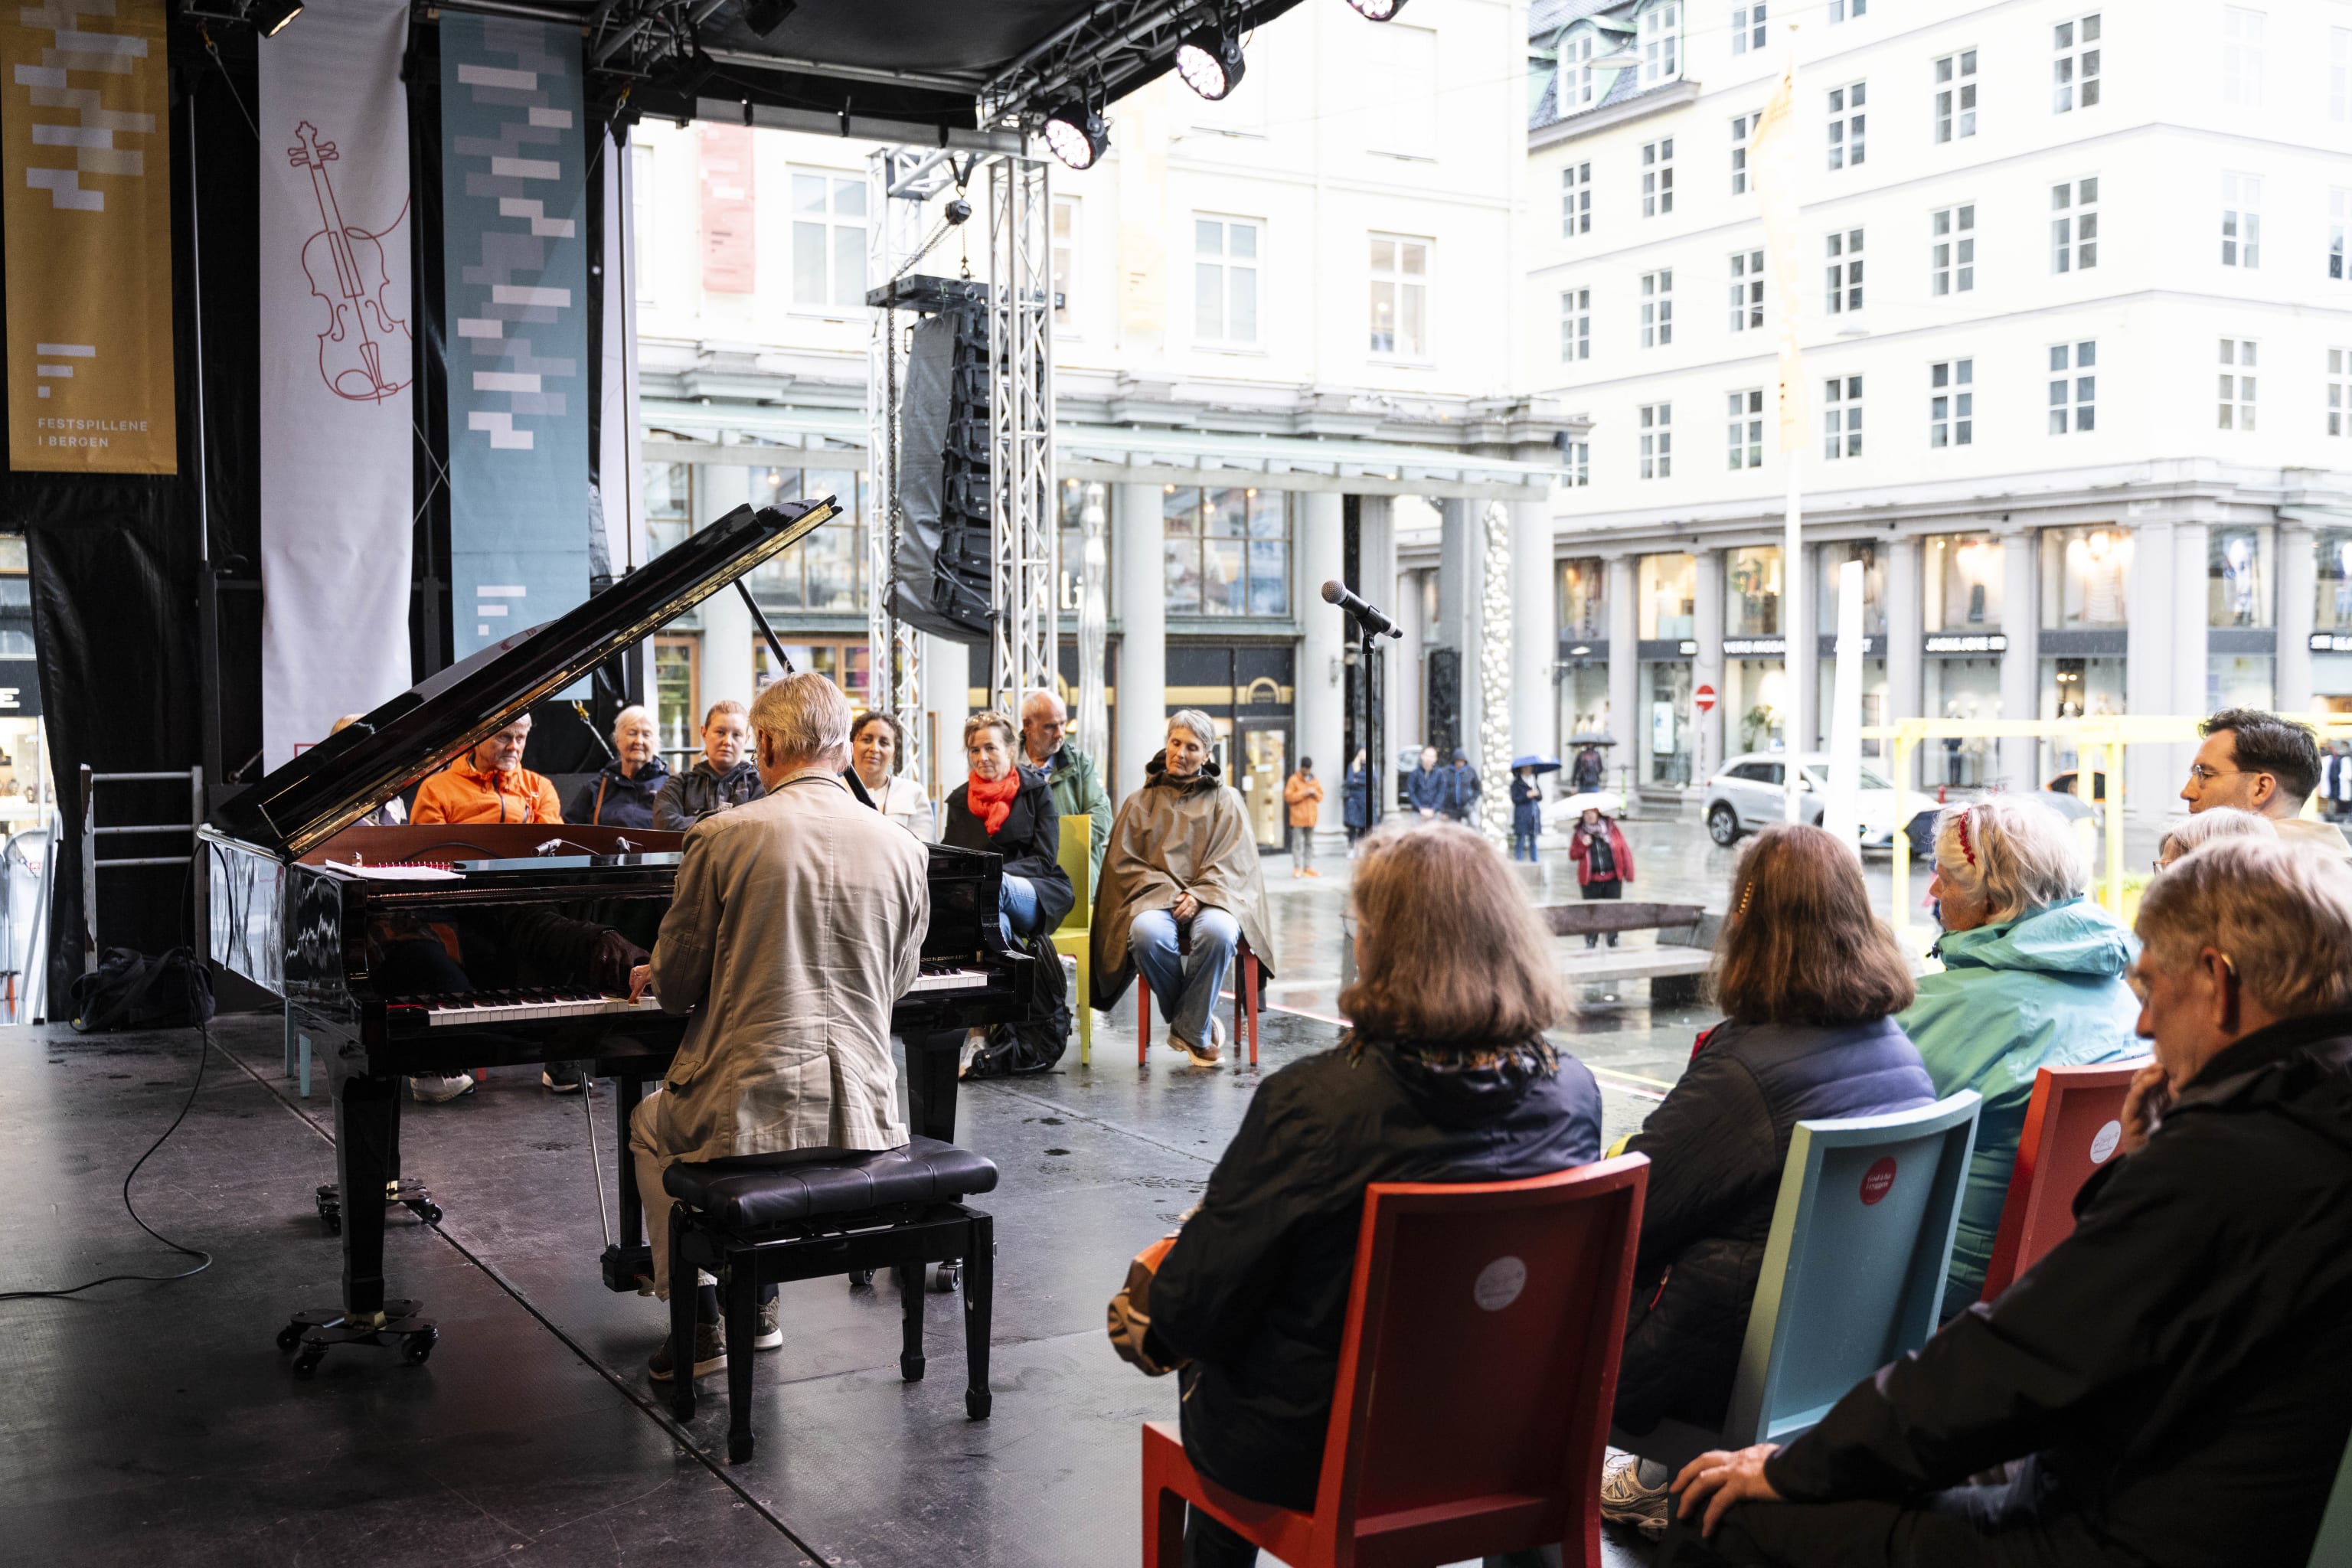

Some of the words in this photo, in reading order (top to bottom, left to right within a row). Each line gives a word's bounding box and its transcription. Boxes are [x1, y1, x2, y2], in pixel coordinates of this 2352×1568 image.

[38, 418, 148, 432] FESTSPILLENE
[38, 436, 42, 446] I
[48, 436, 109, 447] BERGEN
